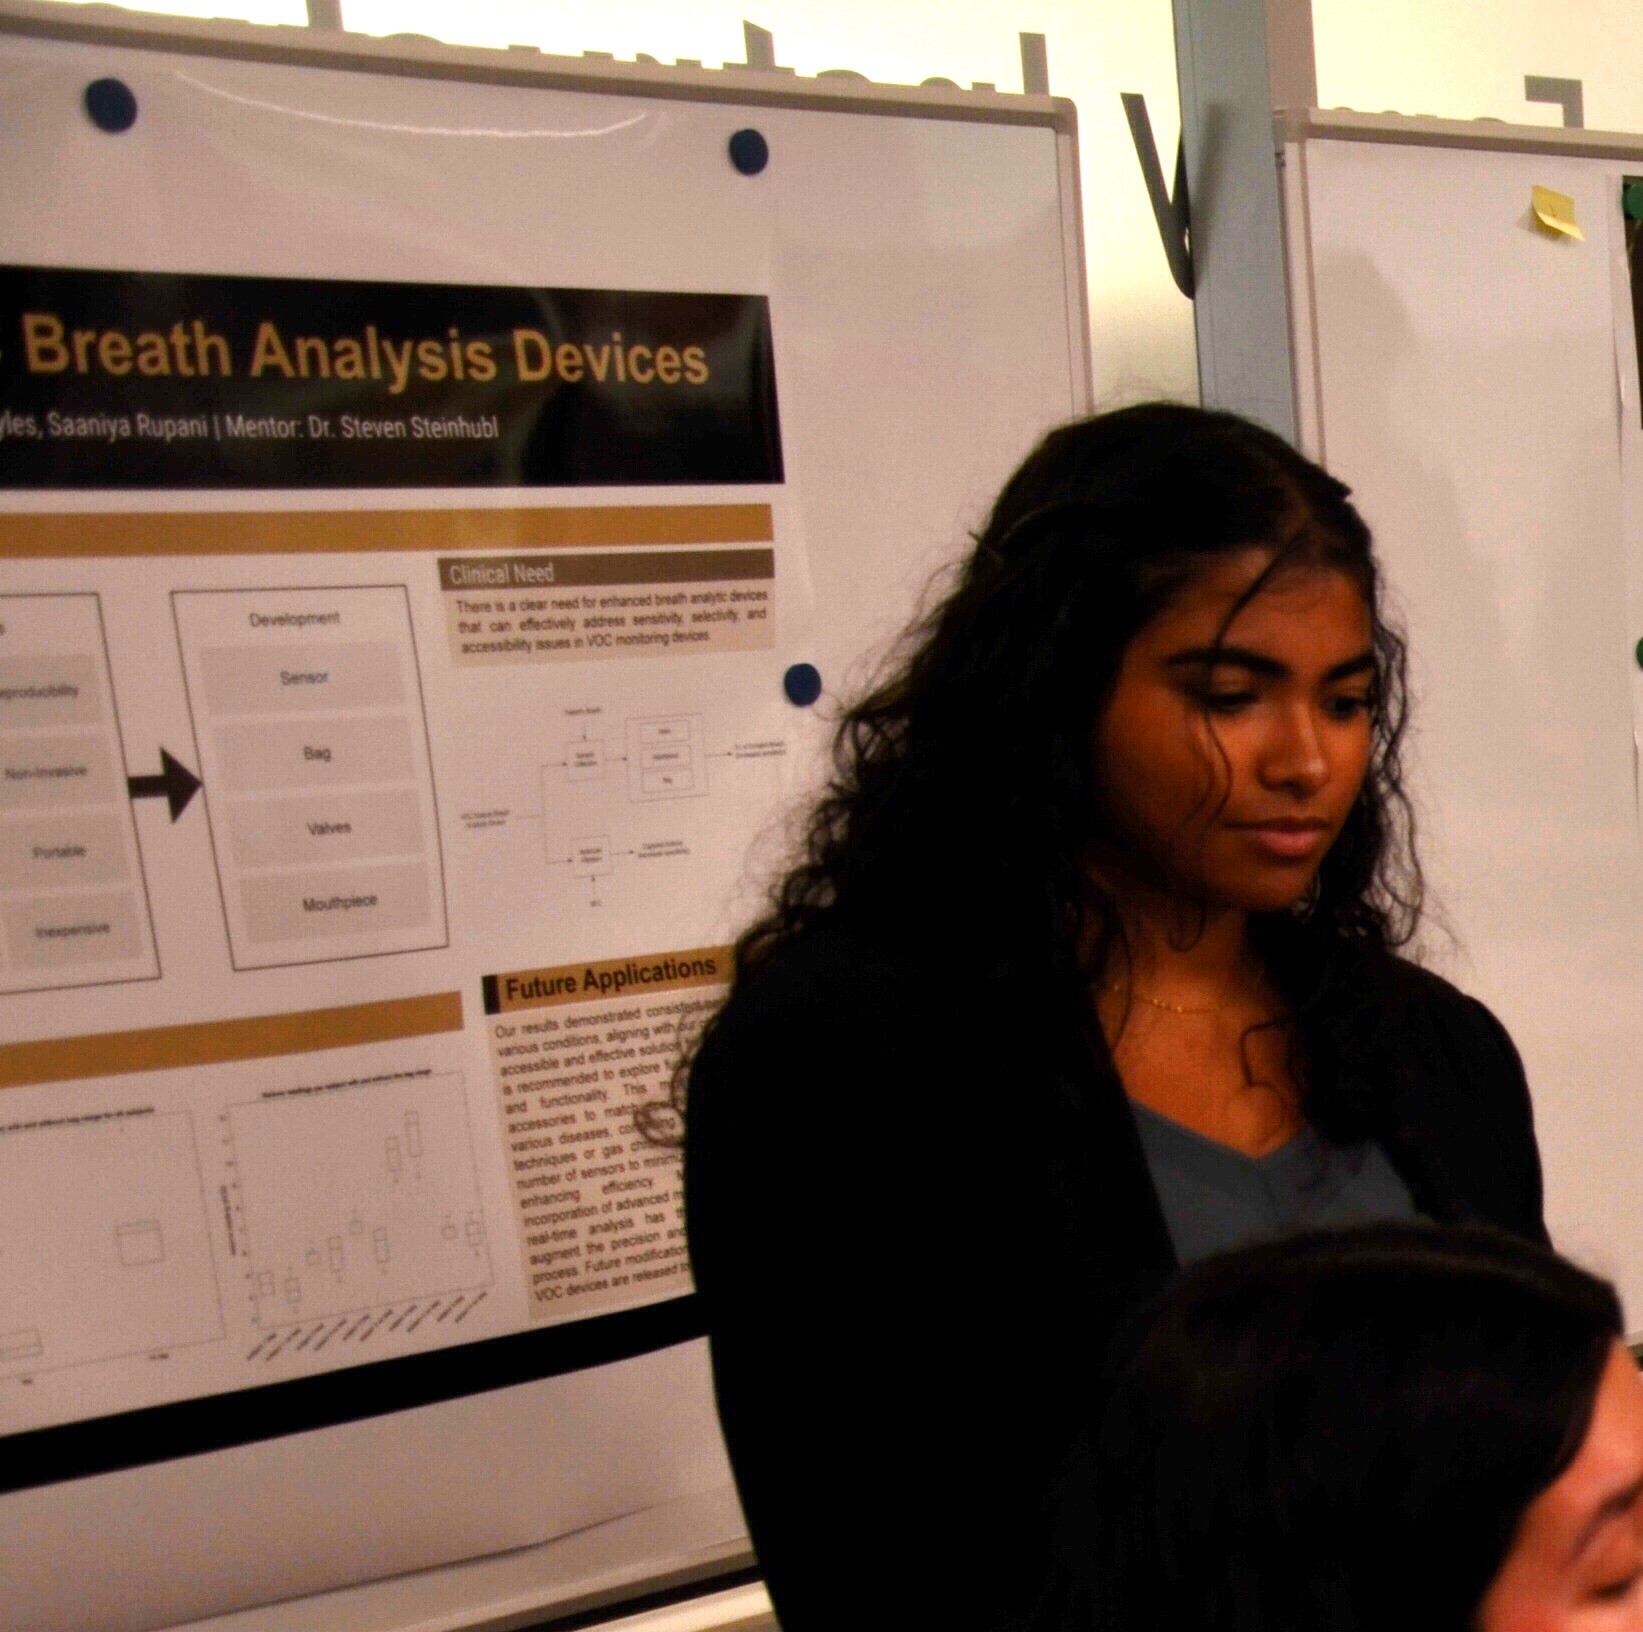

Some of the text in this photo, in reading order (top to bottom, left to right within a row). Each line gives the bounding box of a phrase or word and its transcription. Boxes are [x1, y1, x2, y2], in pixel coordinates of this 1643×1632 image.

[21, 312, 710, 395] Breath Analysis Devices
[48, 411, 131, 442] Saaniya
[136, 413, 208, 443] Rupani
[226, 415, 304, 439] Mentor:
[309, 415, 336, 439] Dr.
[341, 415, 406, 439] Steven
[411, 415, 499, 440] Steinhubl
[450, 561, 553, 585] Clinical Need
[456, 597, 491, 614] There
[495, 600, 505, 612] is
[518, 596, 547, 612] clear
[550, 597, 579, 610] need
[582, 595, 596, 608] for
[599, 592, 651, 609] enhanced
[653, 591, 687, 606] breath
[729, 587, 767, 602] devices
[249, 611, 340, 629] Development
[458, 620, 481, 634] that
[489, 620, 511, 632] can
[518, 613, 575, 635] effectively
[582, 612, 625, 628] address
[745, 606, 767, 620] and
[461, 636, 532, 658] accessibility
[535, 636, 570, 650] issues
[585, 632, 613, 648] VOC
[615, 630, 669, 649] monitoring
[280, 669, 329, 686] Sensor
[303, 746, 332, 763] Bag
[307, 820, 352, 837] Valves
[32, 844, 87, 860] Portable
[303, 893, 378, 914] Mouthpiece
[35, 922, 110, 940] Inexpensive
[505, 954, 717, 1000] Future Applications
[495, 1006, 641, 1039] Our results demonstrated
[498, 1041, 538, 1058] various
[606, 1025, 650, 1046] aligning
[653, 1020, 674, 1035] with
[501, 1055, 559, 1078] accessible
[563, 1052, 585, 1067] and
[587, 1044, 636, 1064] effective
[517, 1069, 599, 1095] recommended
[618, 1061, 660, 1081] explore
[505, 1099, 527, 1115] and
[623, 1080, 648, 1097] This
[507, 1111, 576, 1135] accessories
[510, 1134, 553, 1154] various
[513, 1149, 577, 1175] techniques
[601, 1142, 623, 1160] gas
[515, 1171, 559, 1191] number
[580, 1160, 625, 1181] sensors
[519, 1188, 579, 1213] enhancing
[522, 1204, 598, 1230] incorporation
[615, 1189, 669, 1211] advanced
[525, 1209, 665, 1248] real-time analysis has
[528, 1243, 580, 1269] augment
[585, 1239, 604, 1255] the
[609, 1229, 660, 1252] precision
[584, 1254, 621, 1275] Future
[535, 1262, 677, 1303] VOC devices are released
